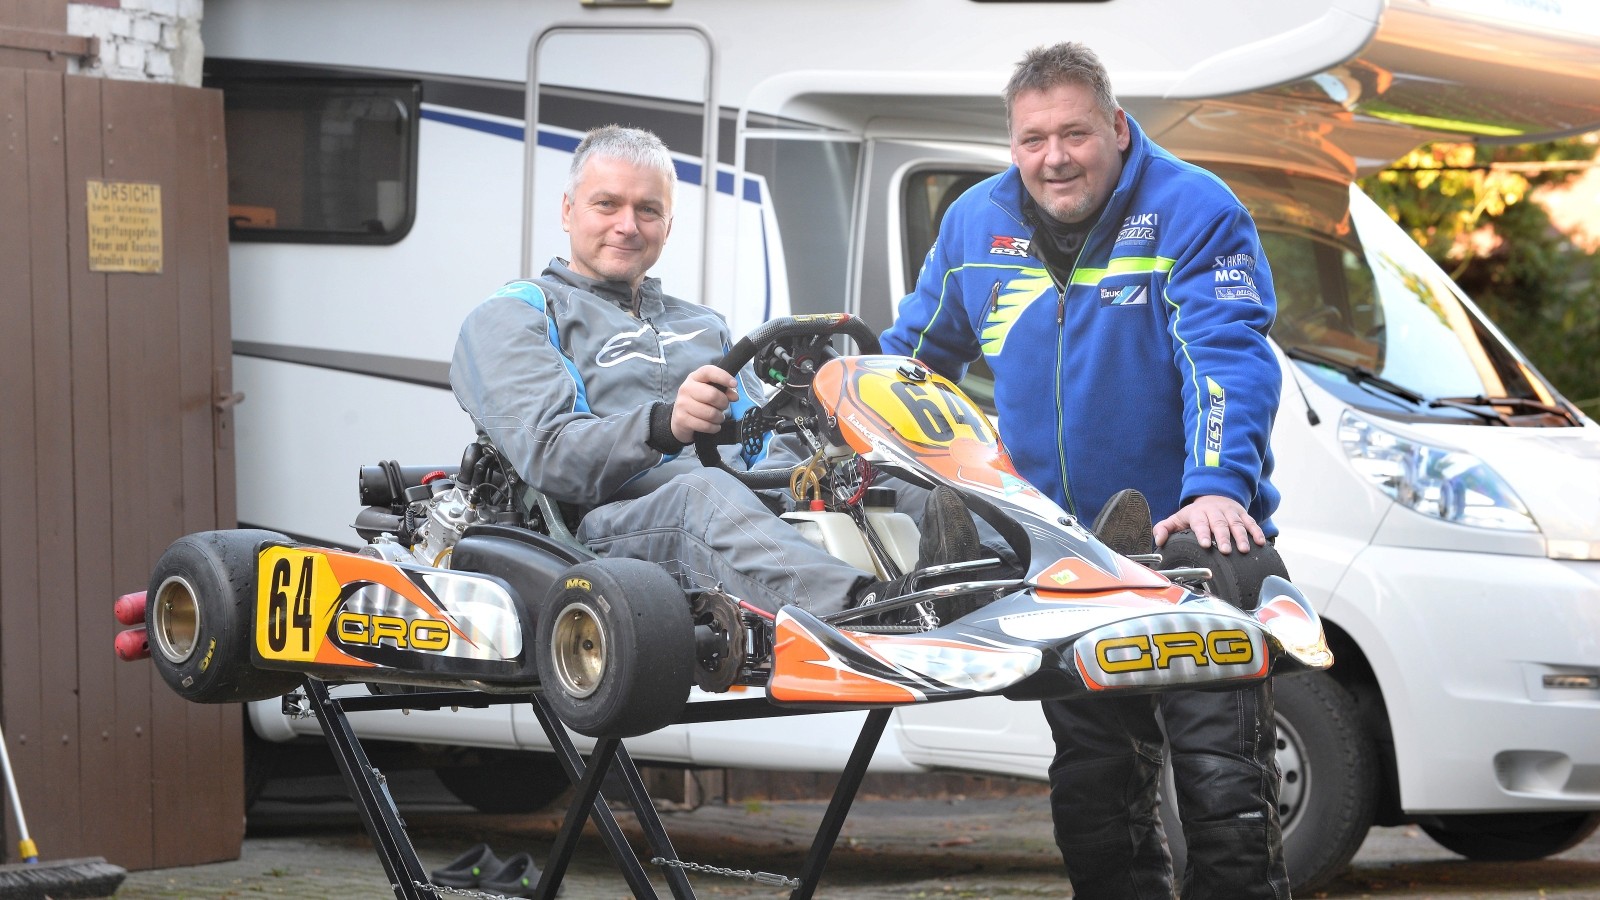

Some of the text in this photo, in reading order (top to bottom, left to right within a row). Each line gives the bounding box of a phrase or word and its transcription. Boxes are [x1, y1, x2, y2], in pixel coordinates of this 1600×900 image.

[92, 184, 156, 202] VORSICHT
[1123, 213, 1158, 227] ZUKI
[1115, 226, 1156, 243] STAR
[989, 247, 1029, 258] GSX
[889, 380, 989, 443] 64
[1206, 389, 1224, 452] ECSTAR
[565, 578, 592, 592] MG
[268, 556, 312, 652] 64
[336, 612, 451, 651] CRG
[1094, 629, 1254, 675] CRG
